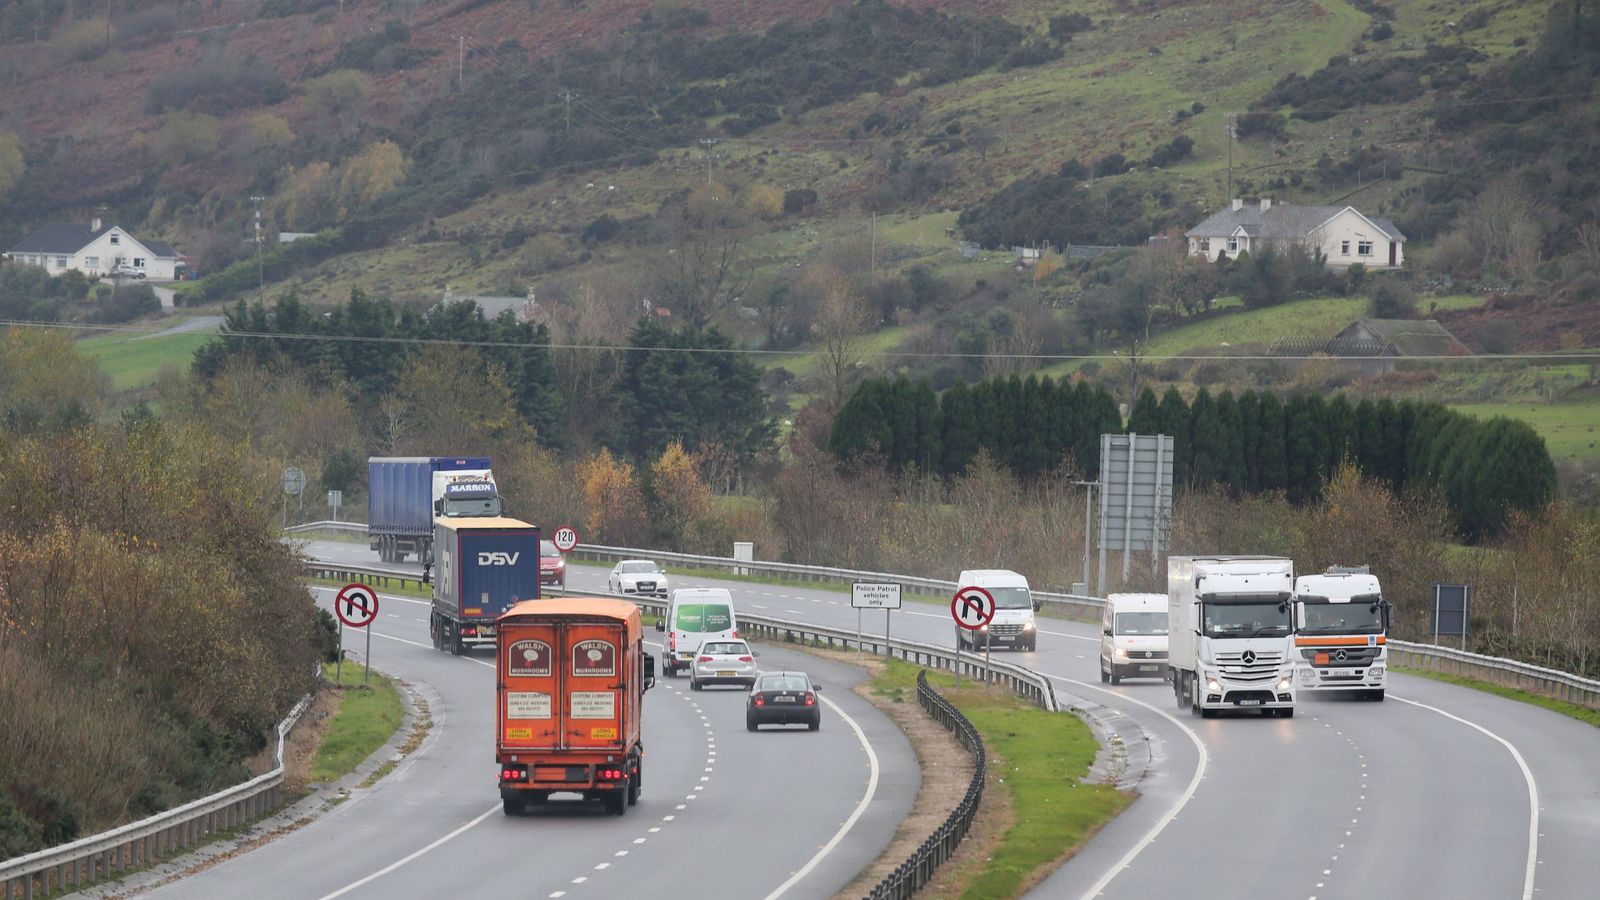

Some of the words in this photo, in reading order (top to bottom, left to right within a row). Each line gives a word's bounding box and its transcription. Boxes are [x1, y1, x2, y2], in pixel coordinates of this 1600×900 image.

[558, 531, 573, 542] 120
[478, 552, 519, 566] DSV
[517, 642, 544, 651] WALSH
[581, 642, 608, 651] WALSH
